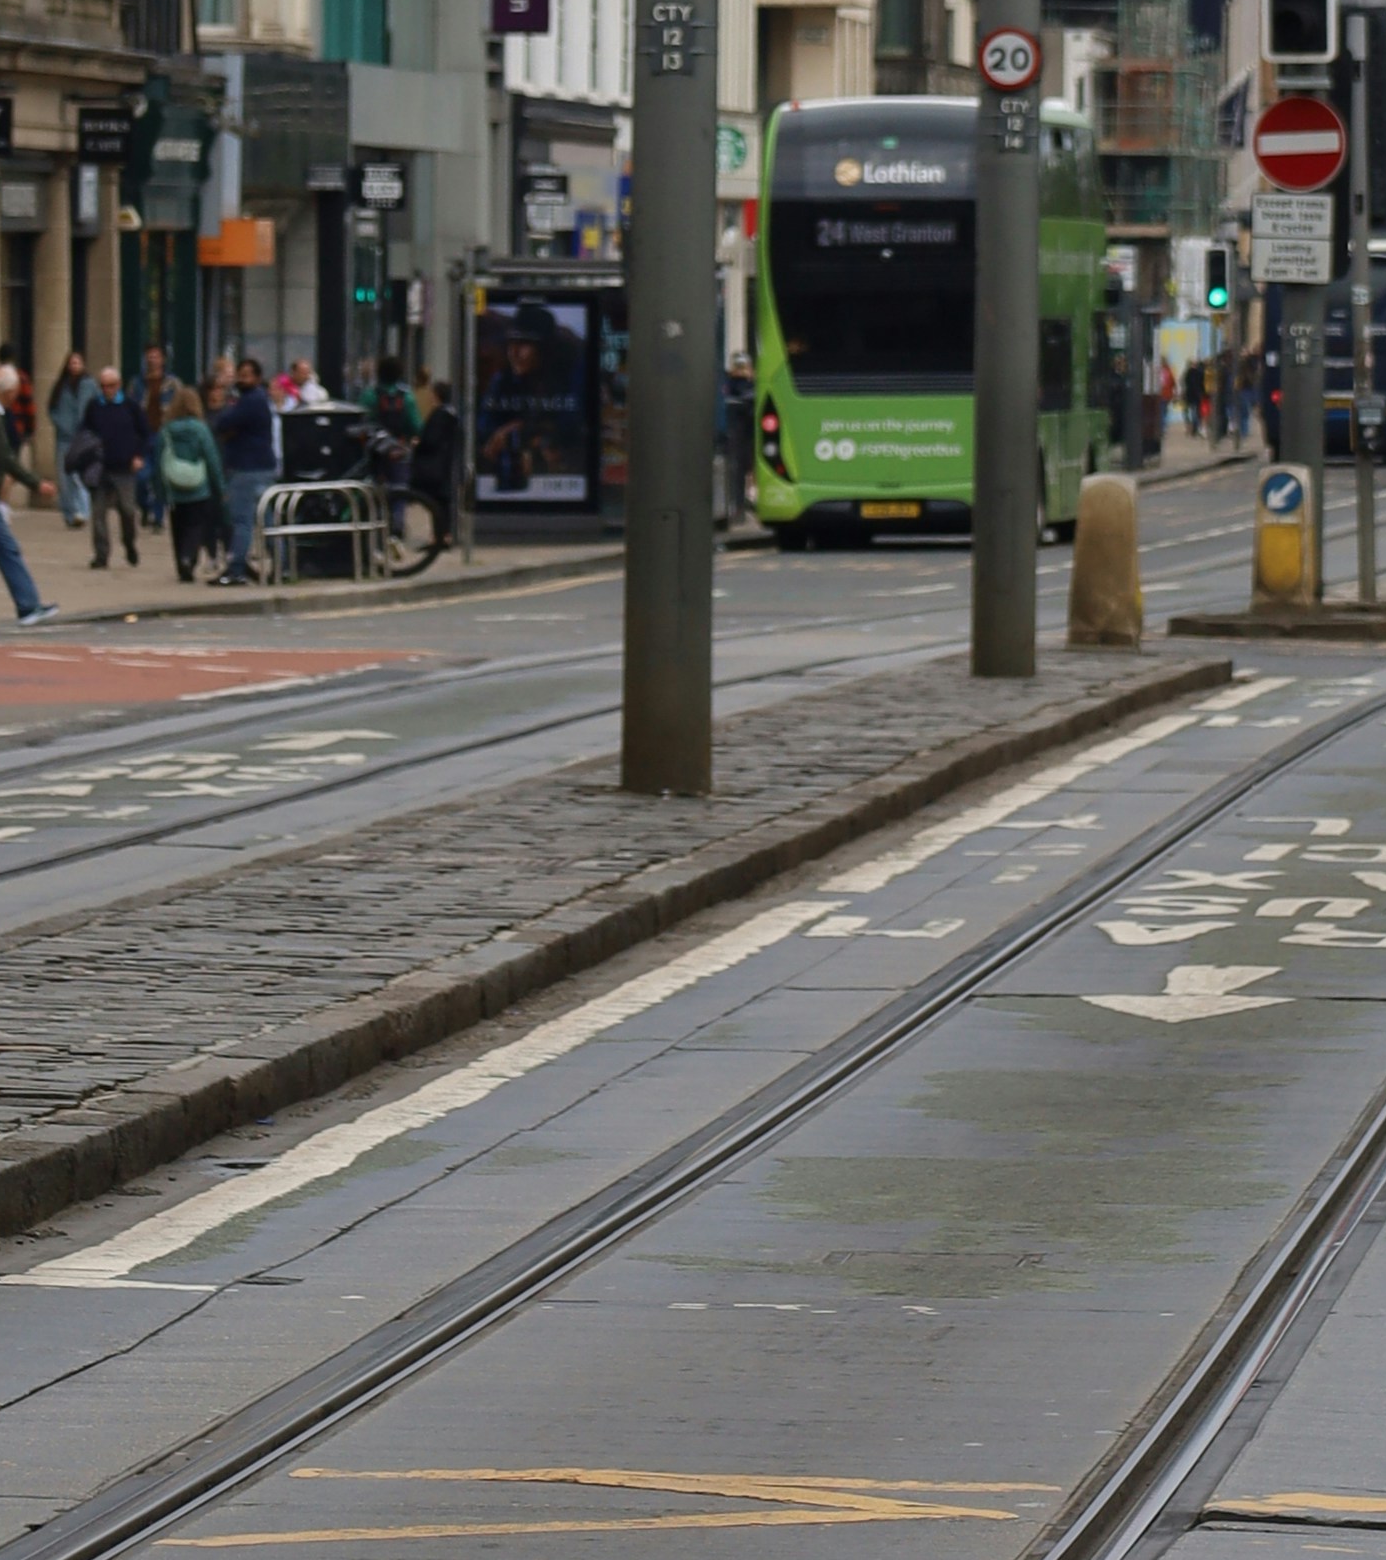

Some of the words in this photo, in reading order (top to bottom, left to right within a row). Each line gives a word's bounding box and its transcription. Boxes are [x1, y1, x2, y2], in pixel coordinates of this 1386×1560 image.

[653, 2, 693, 21] CTY
[663, 27, 683, 46] 12
[989, 48, 1029, 72] 20
[1000, 98, 1030, 114] CTY
[863, 160, 946, 184] Lothian
[817, 219, 844, 246] 24
